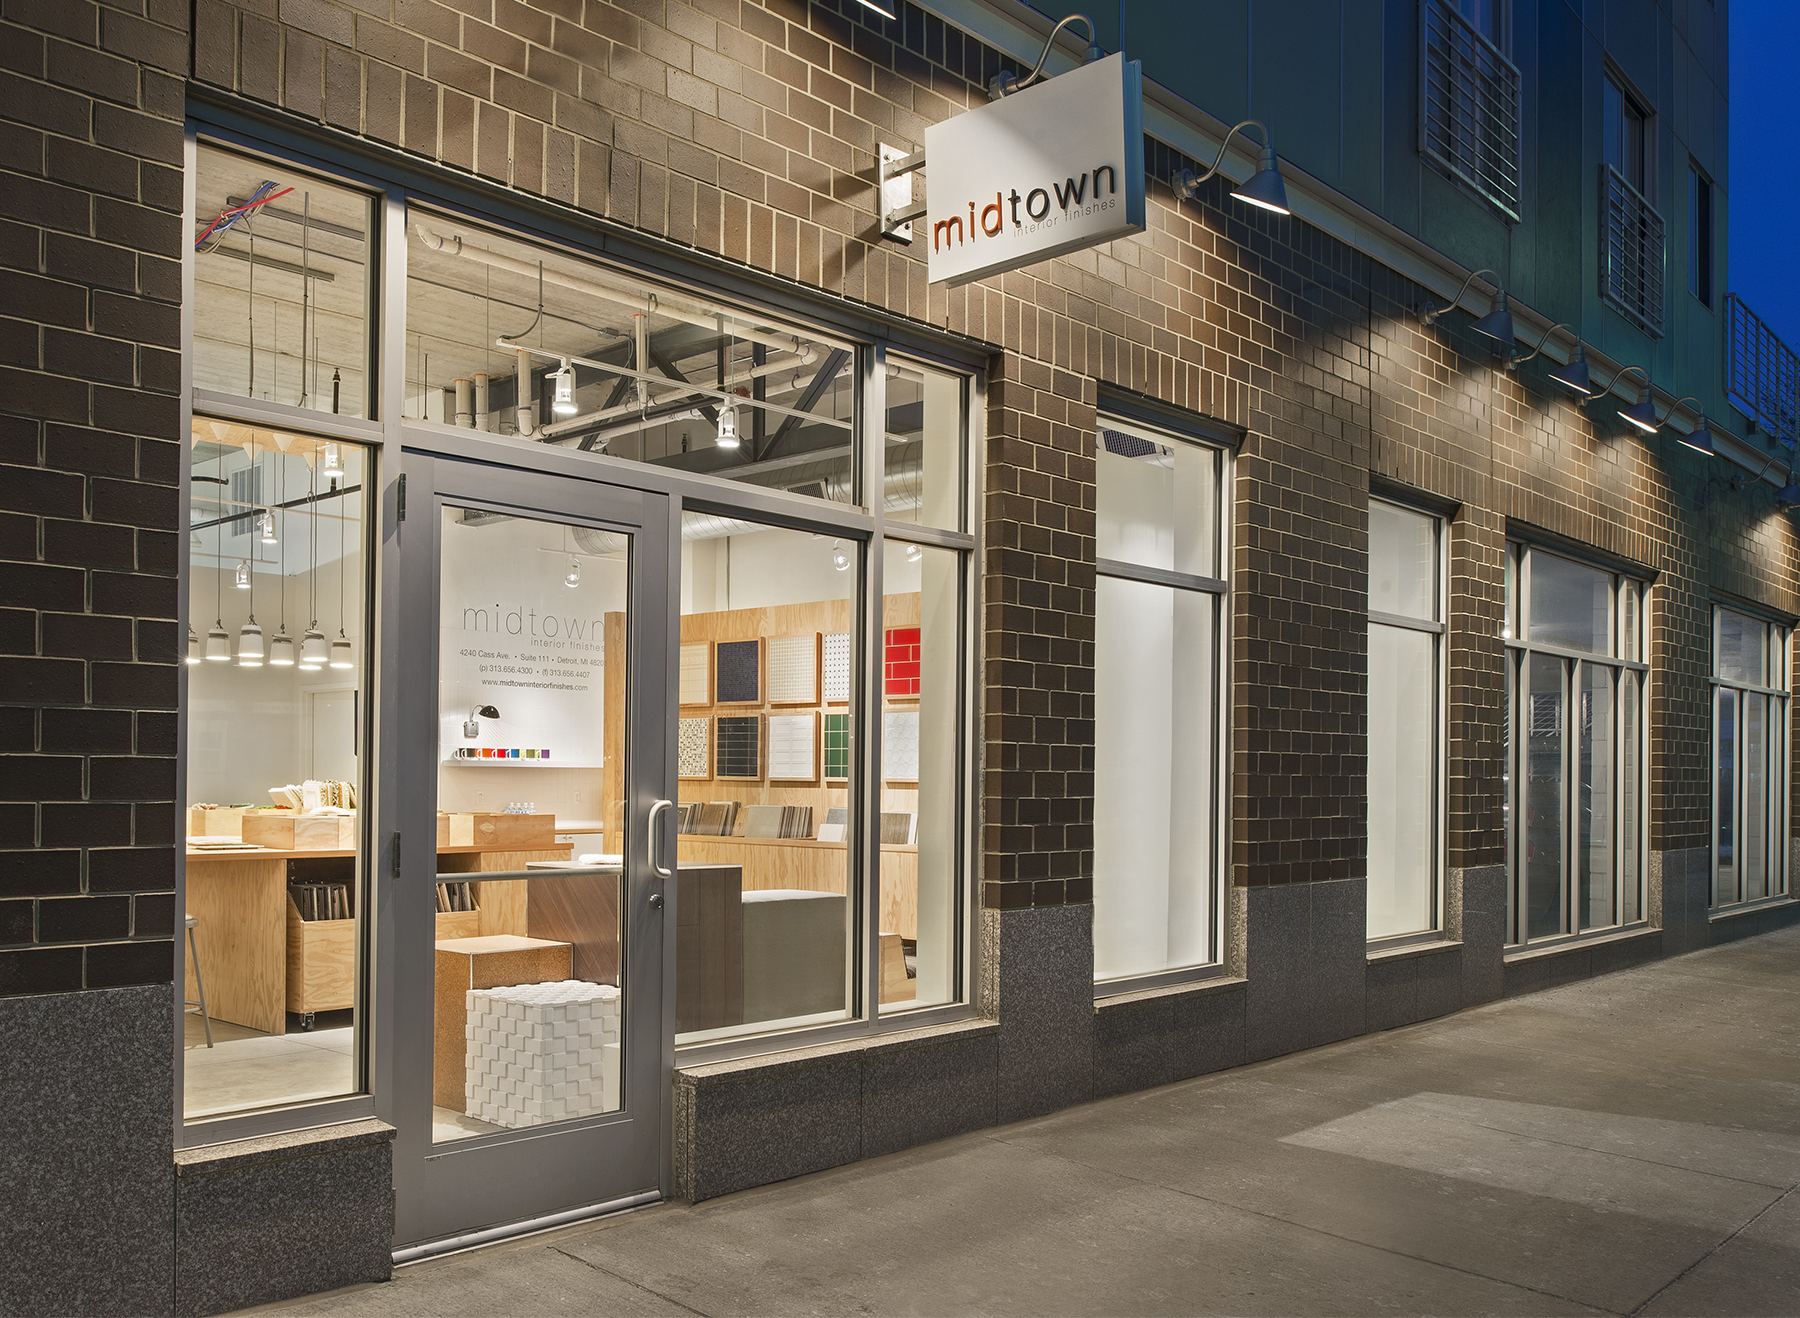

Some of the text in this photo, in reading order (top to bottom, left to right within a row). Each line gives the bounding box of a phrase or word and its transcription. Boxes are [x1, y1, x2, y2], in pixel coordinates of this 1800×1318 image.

[934, 165, 1115, 255] midtown
[1013, 197, 1116, 238] interior finishes
[463, 603, 605, 641] midtown
[530, 637, 605, 652] interior finishes
[459, 648, 477, 658] 4240
[478, 649, 496, 659] Cass
[496, 651, 511, 660] Ave.
[520, 653, 538, 662] Suite
[538, 654, 550, 663] 111
[557, 655, 579, 667] Detroit,
[580, 658, 589, 667] MI
[479, 664, 488, 673] (p)
[489, 664, 533, 676] 313.656.4300
[549, 668, 591, 679] 313.656.4407
[481, 678, 588, 692] www.midtowninteriorfinishes.com
